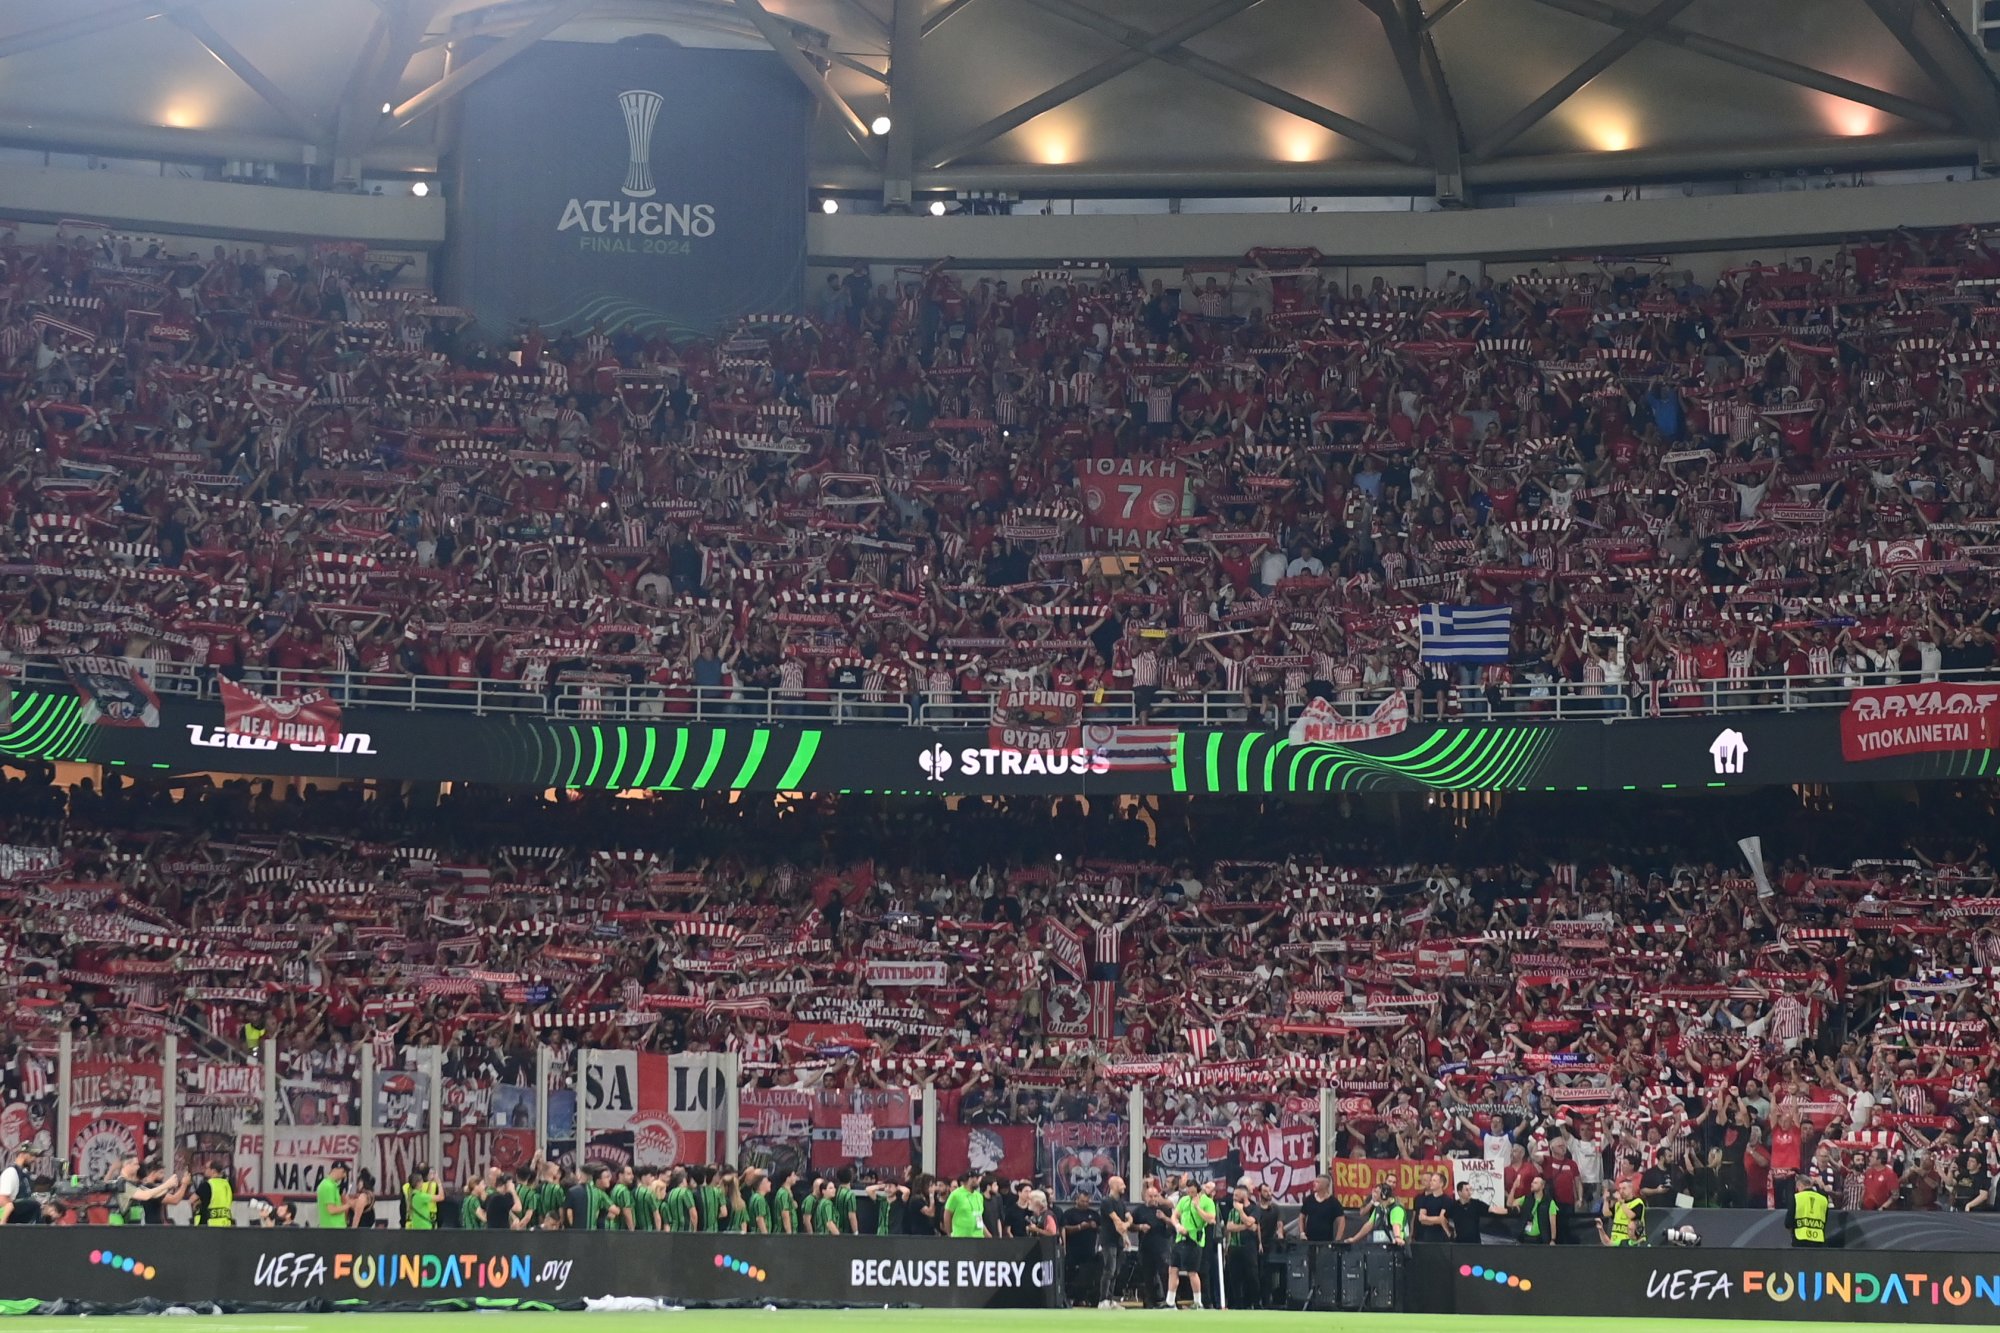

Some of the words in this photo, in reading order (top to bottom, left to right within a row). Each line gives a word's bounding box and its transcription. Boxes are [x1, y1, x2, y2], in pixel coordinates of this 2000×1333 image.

[556, 198, 716, 238] ATHENS
[579, 236, 637, 253] FINAL
[643, 239, 692, 256] 2024
[1117, 485, 1142, 519] 7
[1006, 691, 1077, 708] ΑΓΡΙΝΙΟ
[240, 714, 271, 738] ΝΕΑ
[1003, 728, 1052, 749] ΘΥΡΑ
[1053, 728, 1069, 747] 7
[1858, 723, 1969, 751] ΥΠΟΚΛΙΝΕΤΑΙ
[961, 748, 1110, 775] STRAUSS
[738, 979, 806, 998] ΑΓΡΙΝΙΟ
[1047, 1021, 1088, 1036] Ultras
[586, 1065, 633, 1111] SA
[1892, 1115, 1934, 1124] PIAEUS
[1161, 1142, 1208, 1166] GRE
[1461, 1159, 1496, 1172] ΜΑΚΗΣ
[1269, 1166, 1285, 1193] 7
[1335, 1162, 1372, 1189] RED
[254, 1252, 328, 1288] UEFA
[333, 1253, 531, 1289] FOUNDATION
[535, 1258, 573, 1291] .org
[851, 1258, 950, 1286] BECAUSE
[956, 1260, 1025, 1287] EVERY
[1646, 1268, 1733, 1300] UEFA
[1743, 1270, 2000, 1306] FOUNDATION
